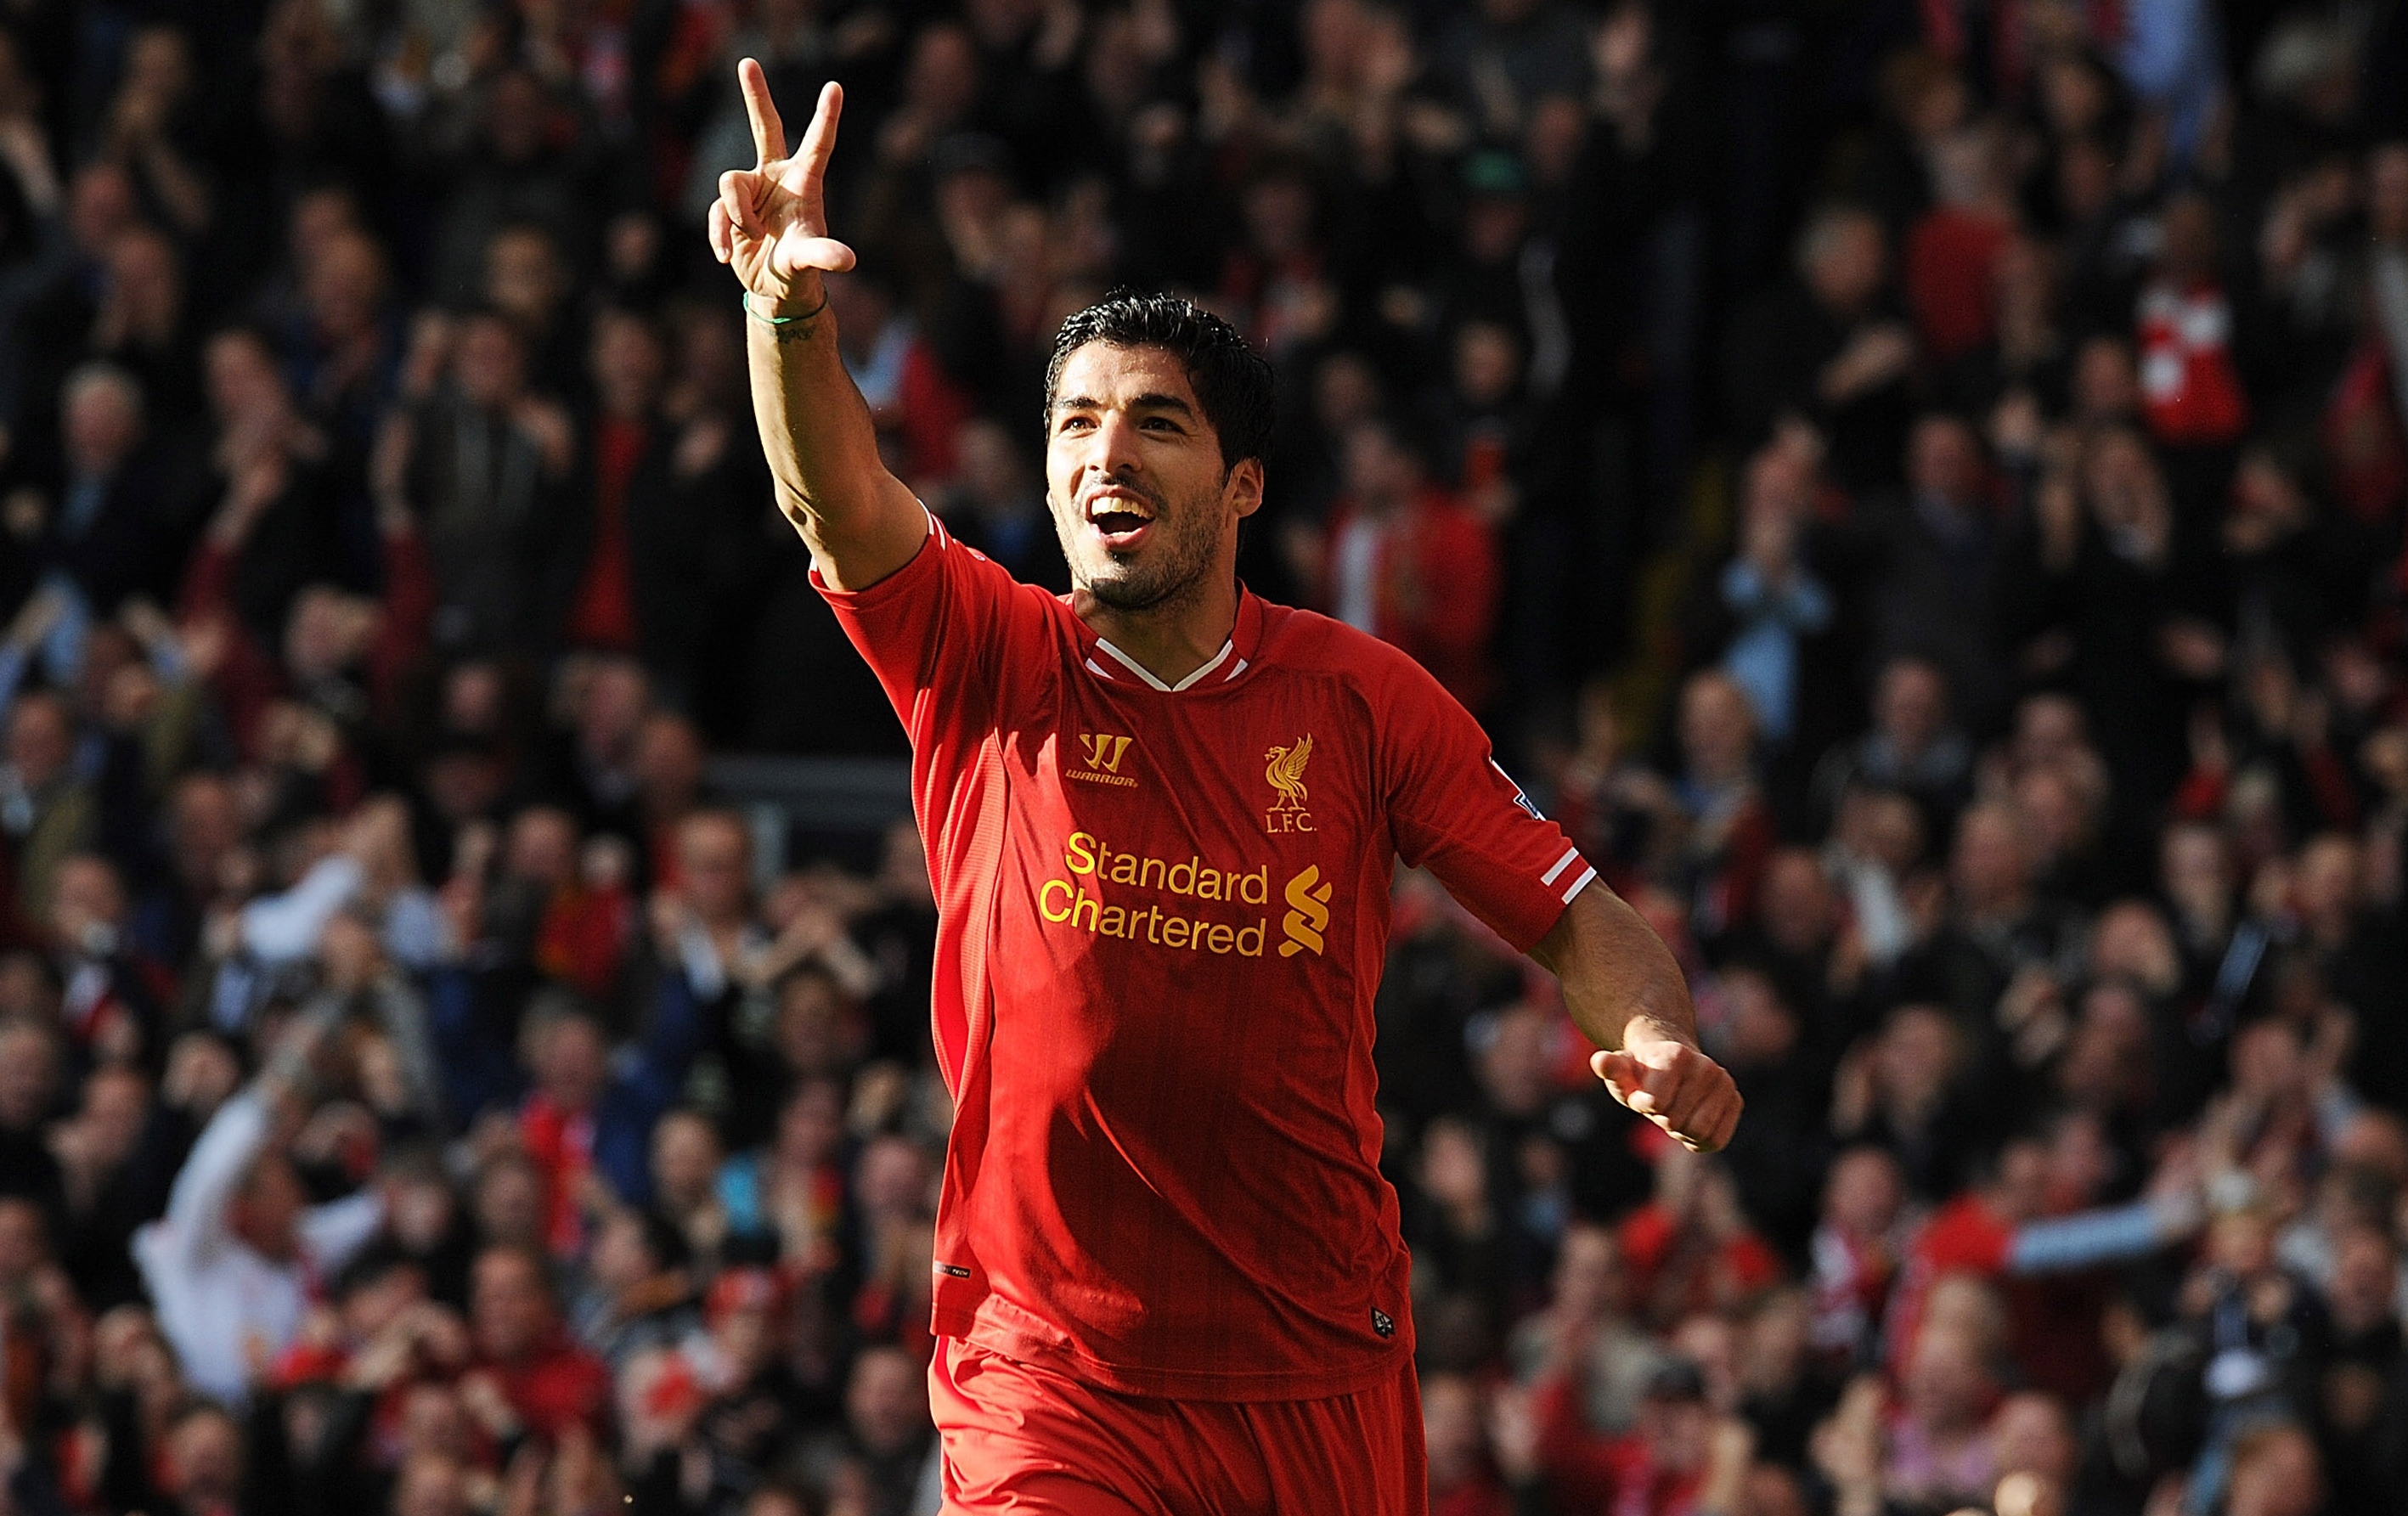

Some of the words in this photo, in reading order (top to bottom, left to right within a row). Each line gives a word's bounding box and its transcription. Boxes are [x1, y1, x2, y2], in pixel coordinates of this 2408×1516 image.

[1065, 769, 1136, 787] WARRIOR
[1265, 813, 1317, 833] L.F.C.
[1065, 831, 1269, 905] Standard
[1039, 879, 1267, 957] Chartered
